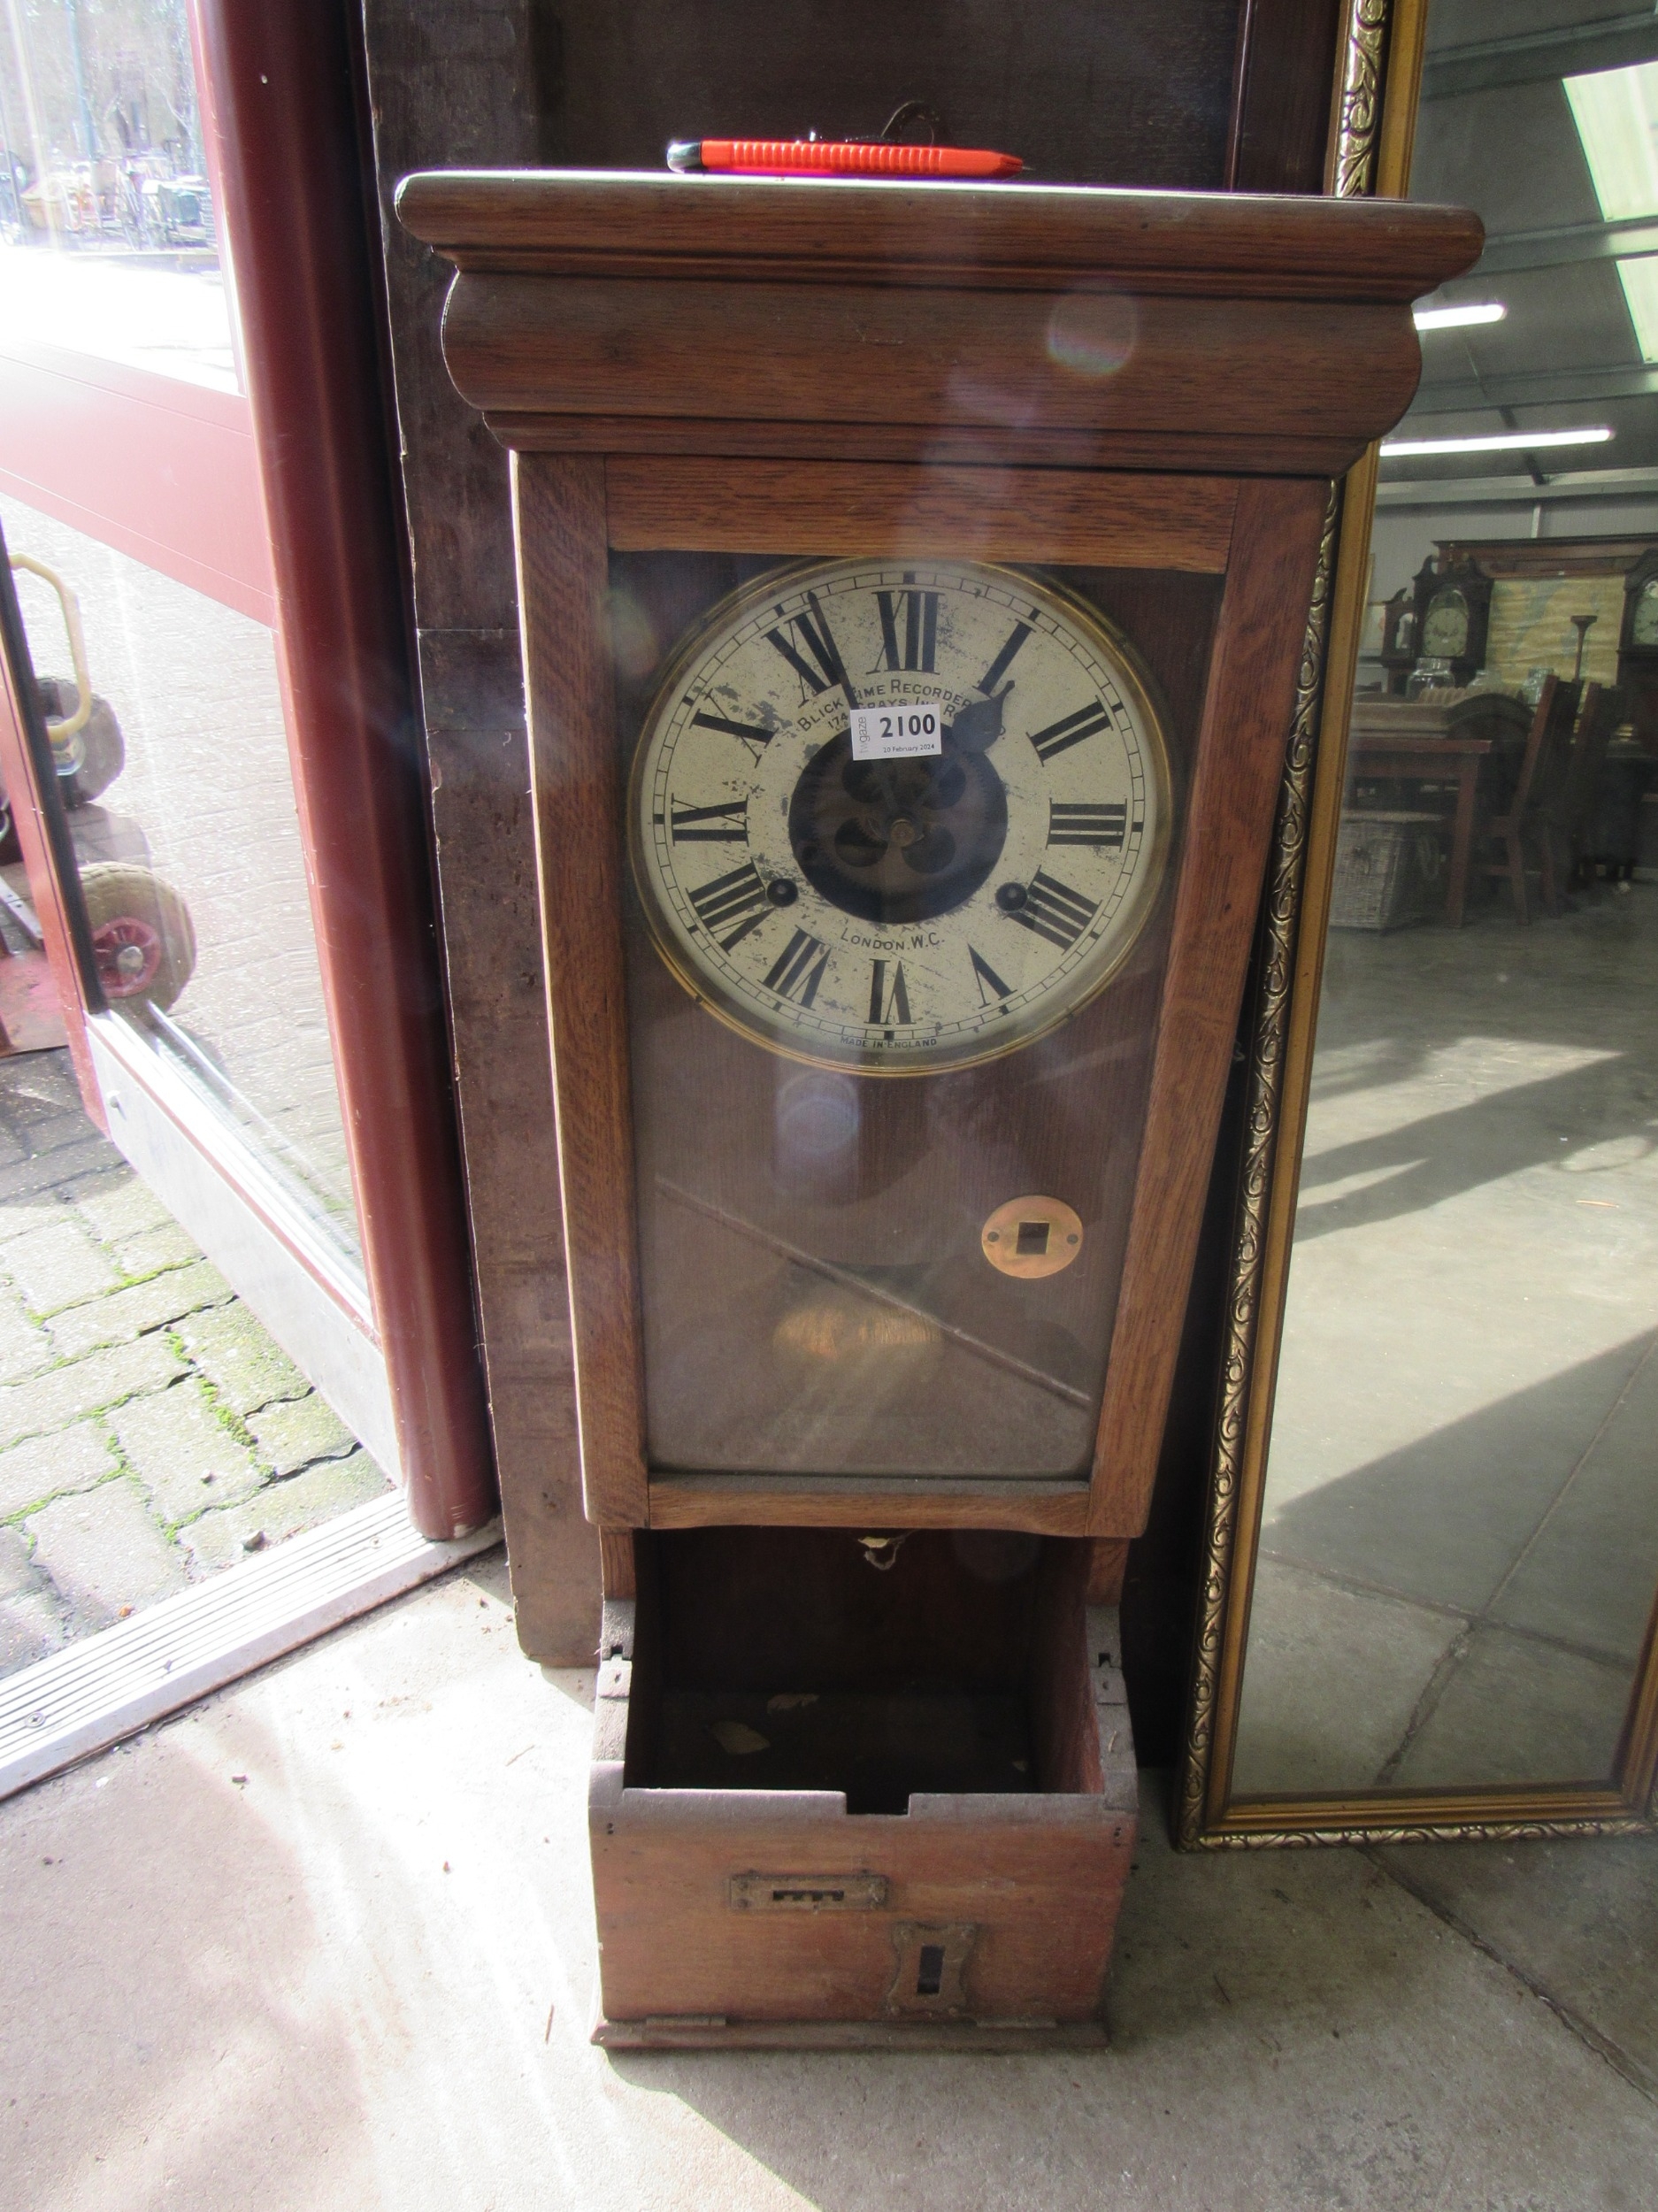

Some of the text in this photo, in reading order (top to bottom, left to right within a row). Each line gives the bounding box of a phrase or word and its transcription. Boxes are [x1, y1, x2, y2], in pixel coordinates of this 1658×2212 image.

[866, 589, 945, 675] XII
[689, 688, 779, 768] X
[797, 697, 844, 732] BLICK
[879, 713, 936, 739] 2100
[1026, 695, 1114, 767] II
[1046, 797, 1128, 853] III
[863, 958, 917, 1025] VI
[967, 942, 1018, 1010] V
[841, 1036, 938, 1049] MADE IN ENGLAND
